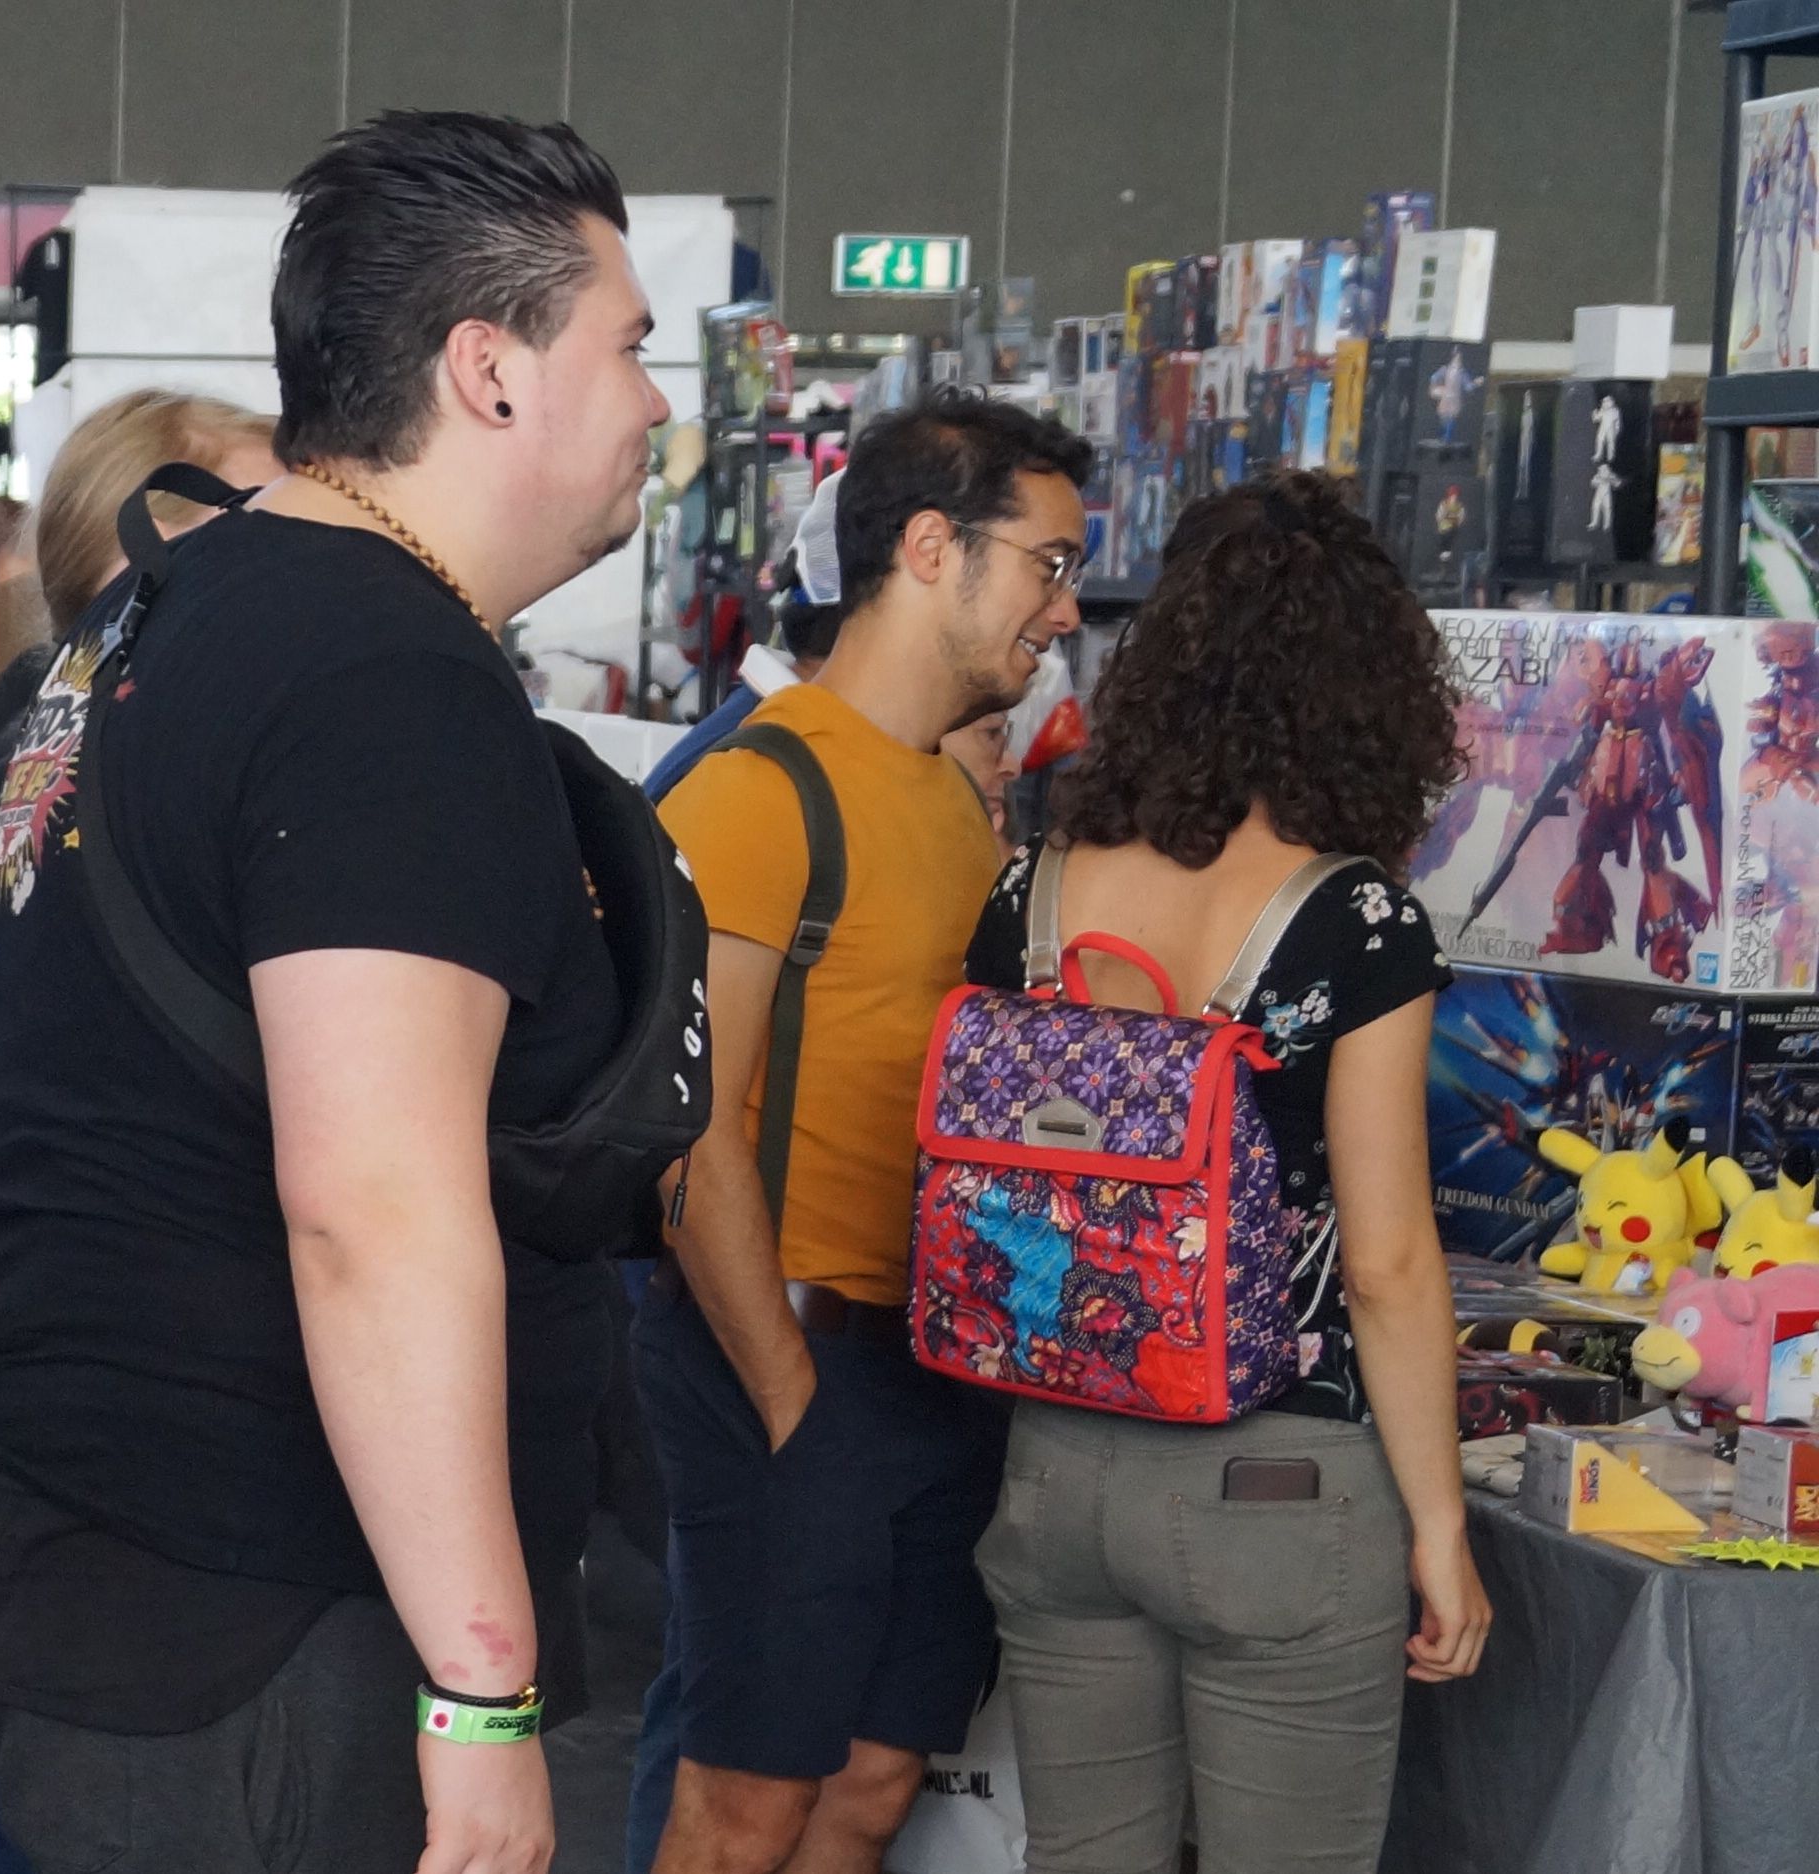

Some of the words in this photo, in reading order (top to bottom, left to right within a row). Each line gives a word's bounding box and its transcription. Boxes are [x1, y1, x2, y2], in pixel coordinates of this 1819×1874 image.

[1477, 617, 1552, 643] ZEON
[1446, 637, 1514, 658] OBILE
[1445, 655, 1550, 687] AZABI
[1437, 1186, 1493, 1211] FREEDOM
